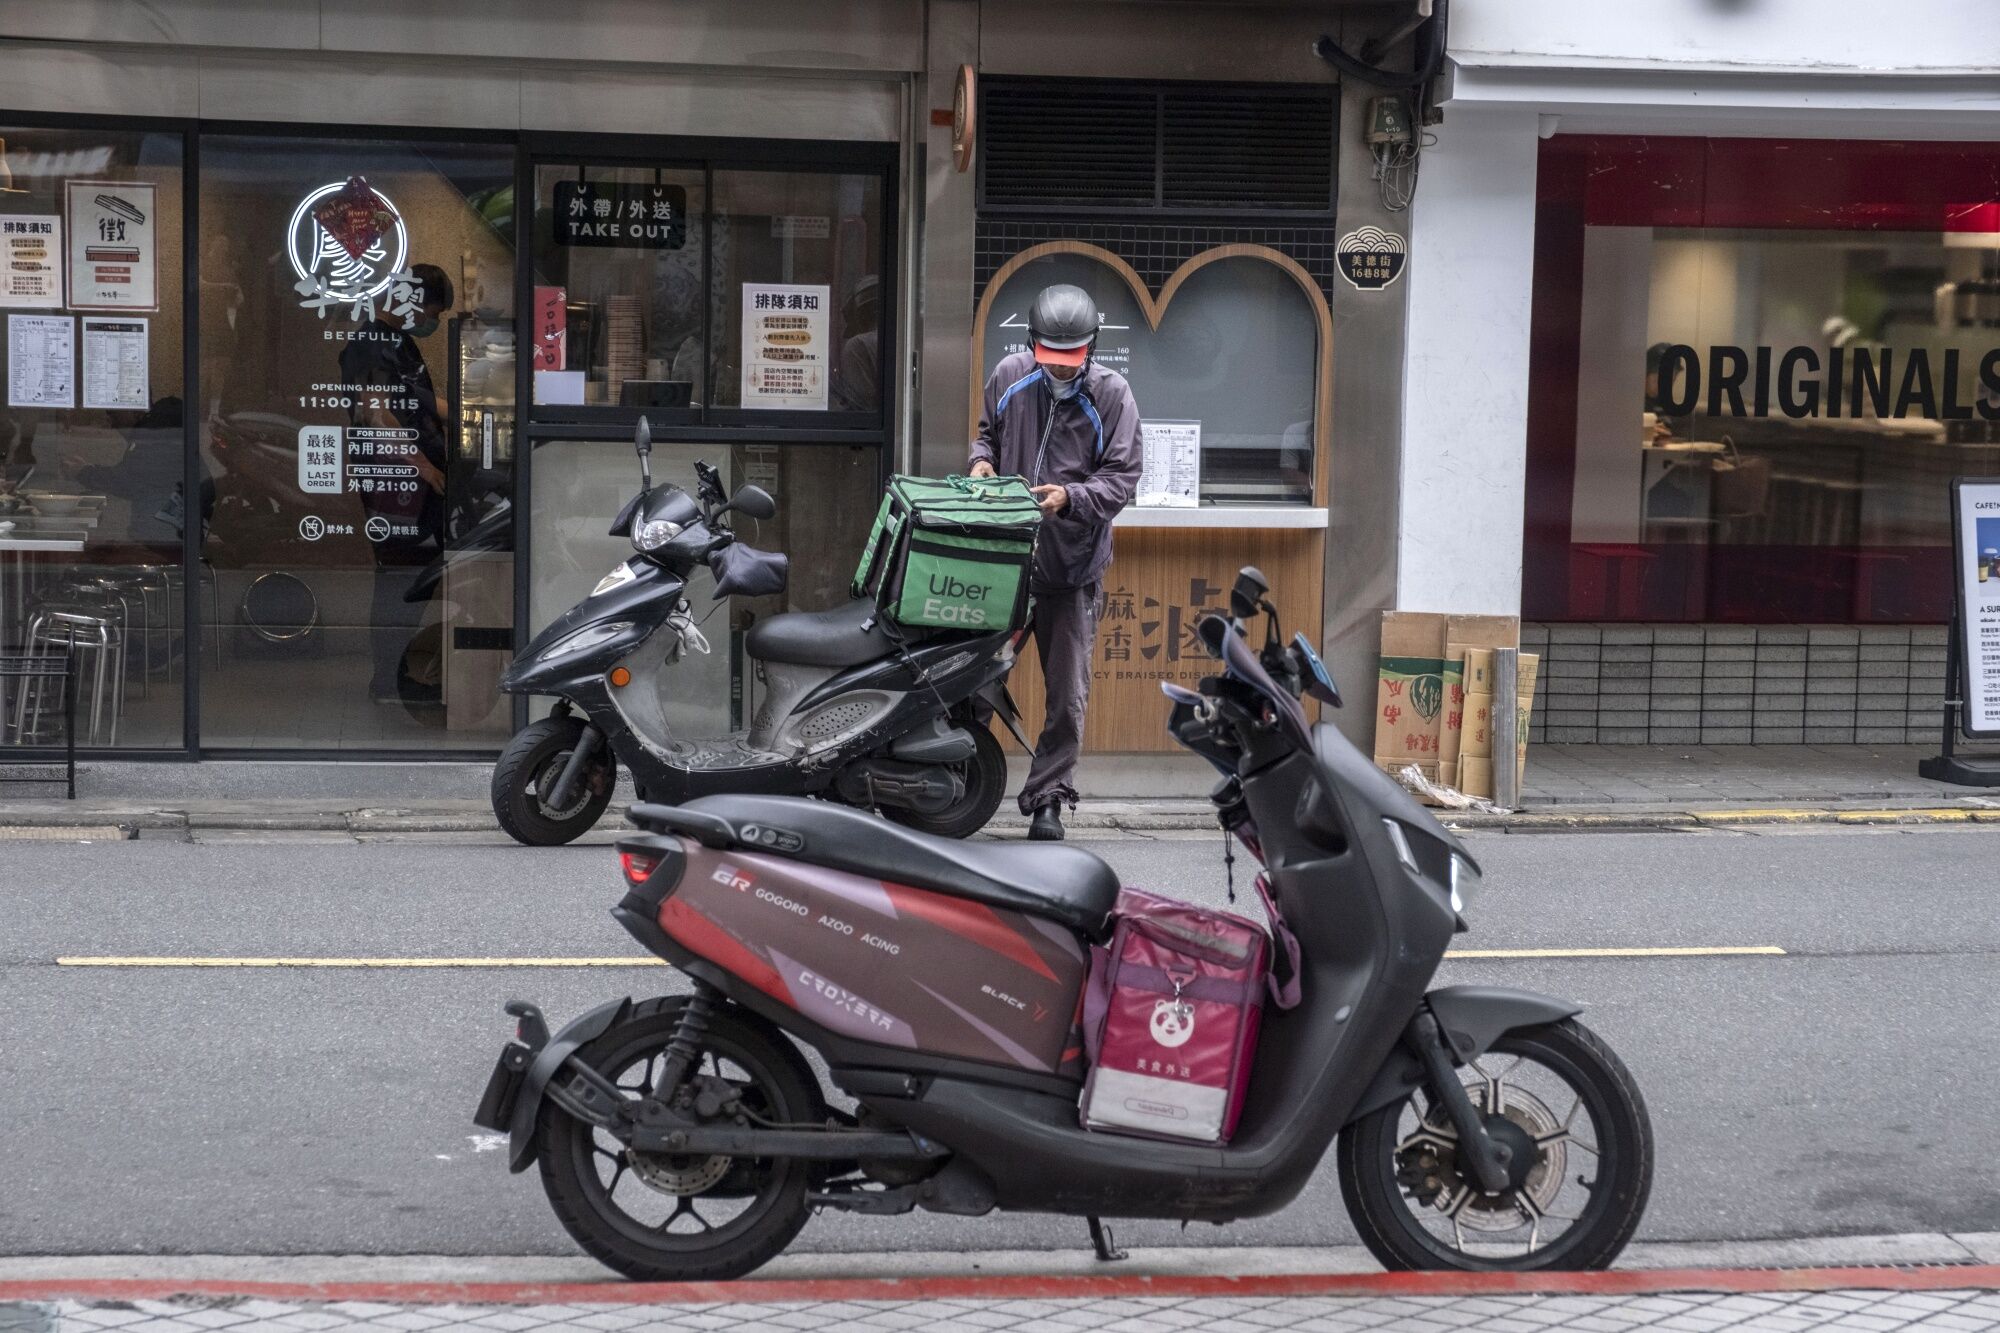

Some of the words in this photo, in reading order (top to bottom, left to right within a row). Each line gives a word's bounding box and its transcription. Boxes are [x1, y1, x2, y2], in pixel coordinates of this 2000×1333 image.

[3, 221, 52, 234] 排隊須知
[99, 217, 126, 242] 徵
[569, 222, 620, 237] TAKE
[629, 224, 671, 239] OUT
[1351, 254, 1392, 267] 美德街
[1351, 268, 1390, 279] 16巷8號
[755, 292, 819, 310] 排隊須知
[323, 330, 402, 343] BEEFULL
[1009, 343, 1031, 353] 招牌
[1120, 367, 1129, 375] 50
[311, 383, 363, 392] OPENING
[366, 384, 406, 393] HOURS
[1658, 344, 2000, 420] ORIGINALS
[299, 396, 351, 408] 11:00
[369, 397, 419, 410] 21:15
[306, 434, 336, 449] 最後
[376, 444, 418, 455] 20:50
[306, 451, 336, 466] 點餐
[307, 471, 335, 479] LAST
[348, 479, 374, 493] 外帶
[377, 481, 418, 492] 21:00
[326, 524, 354, 535] 禁外食
[929, 573, 992, 601] Uber
[922, 598, 986, 625] Eats
[1116, 671, 1175, 680] BRAISED
[1179, 671, 1222, 680] DIS
[1383, 679, 1405, 726] 南瓜
[711, 869, 752, 893] GR
[755, 887, 810, 917] GOGORO
[798, 970, 895, 1032] CROXERA
[980, 984, 1027, 1011] BLACK
